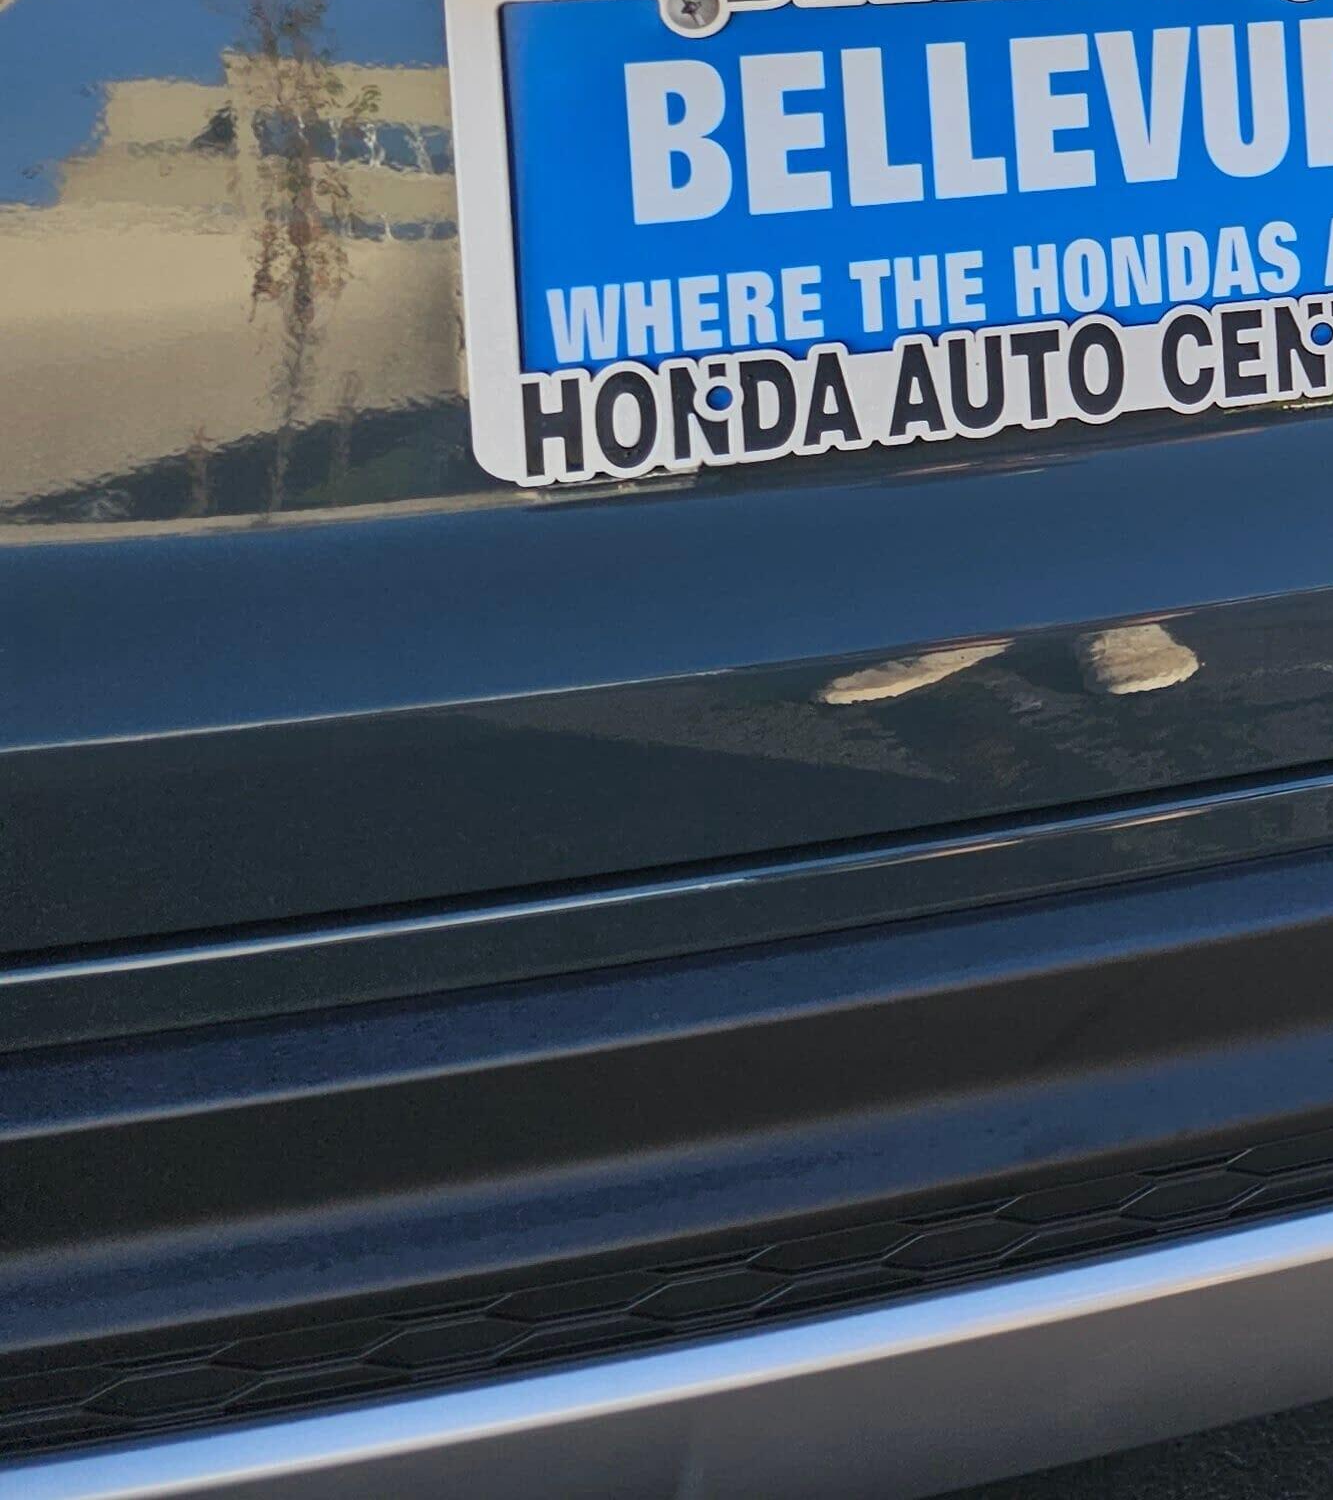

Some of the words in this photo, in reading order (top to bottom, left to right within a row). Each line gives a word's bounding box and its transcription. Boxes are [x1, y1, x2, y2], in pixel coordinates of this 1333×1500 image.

[546, 265, 825, 364] WHERE
[848, 249, 987, 333] THE
[1012, 220, 1301, 318] HONDAS
[519, 352, 862, 478] HONDA
[888, 322, 1126, 438] AUTO
